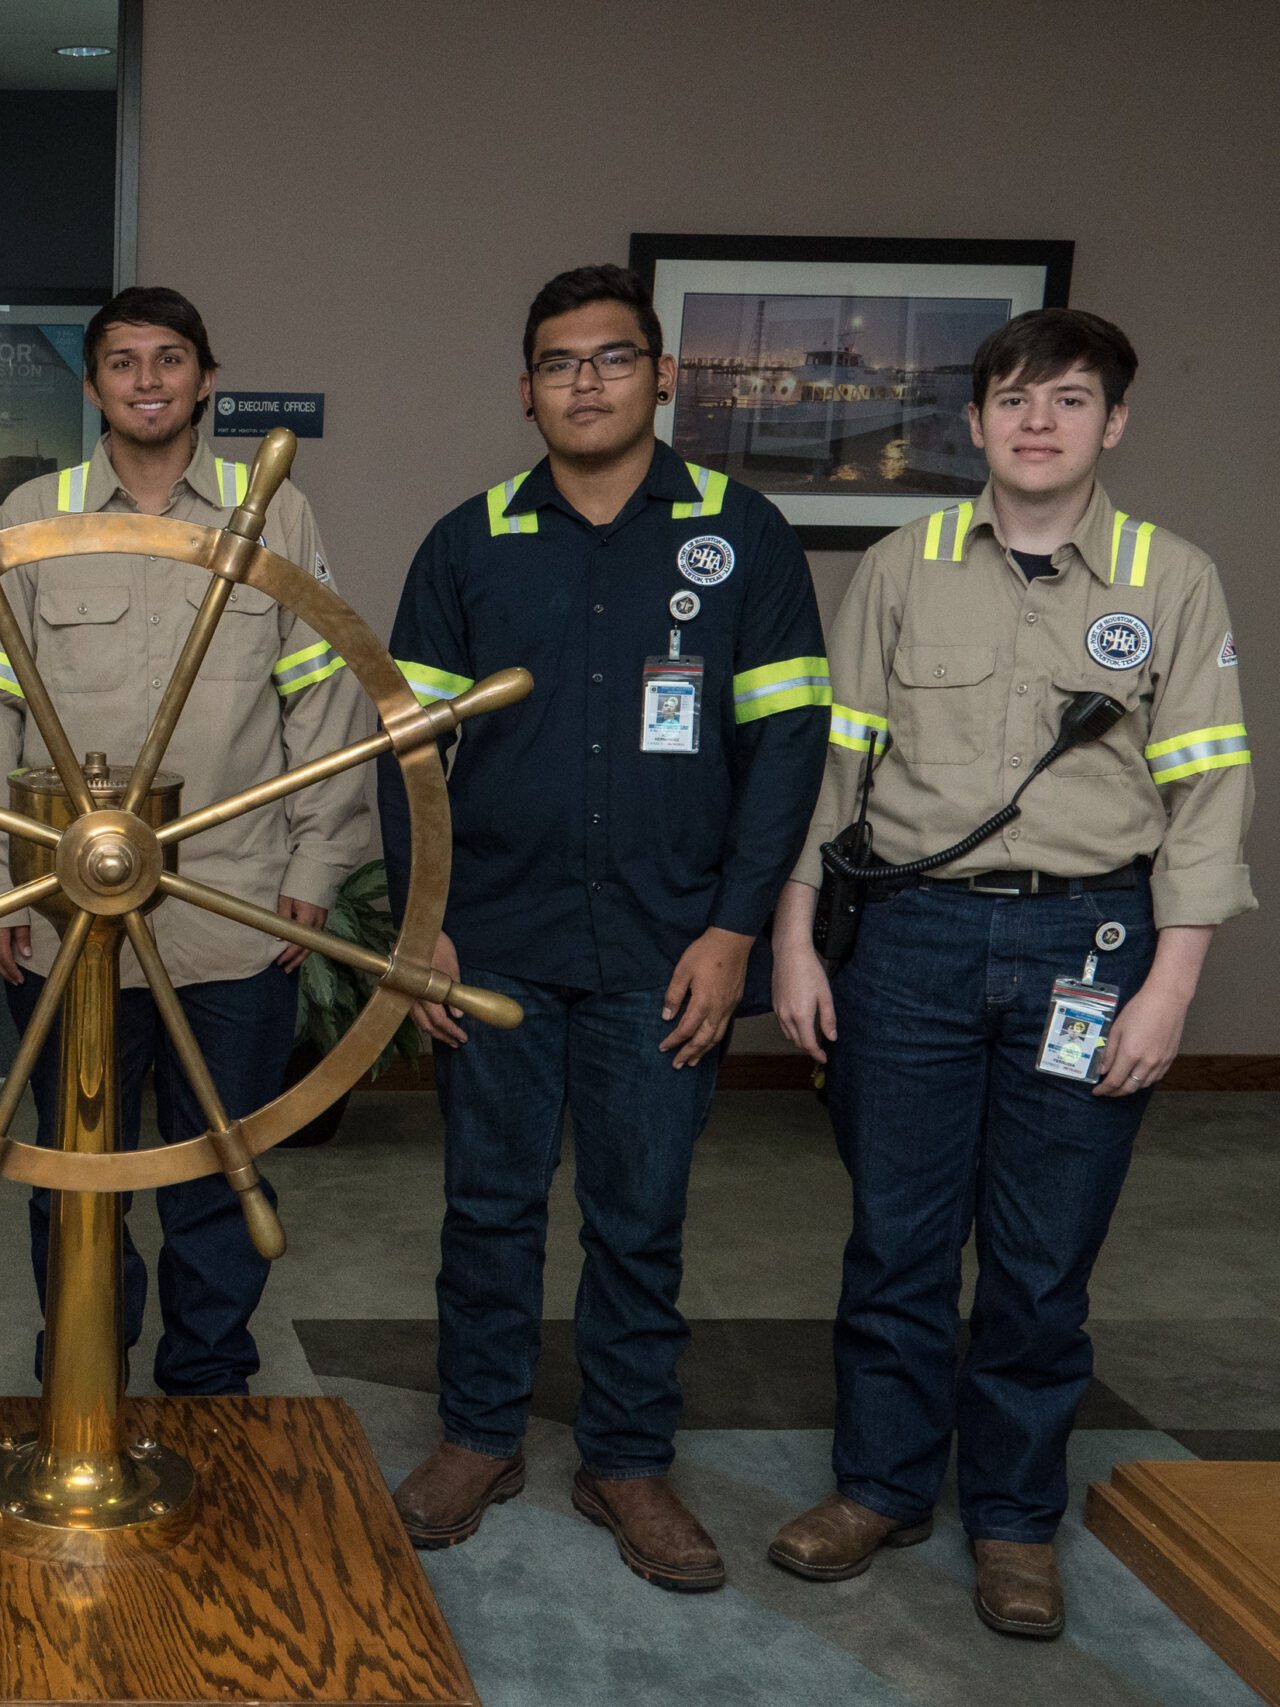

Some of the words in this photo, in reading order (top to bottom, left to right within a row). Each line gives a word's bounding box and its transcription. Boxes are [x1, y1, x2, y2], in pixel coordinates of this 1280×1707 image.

[238, 401, 280, 412] EXECUTIVE
[284, 402, 316, 413] OFFICES
[1103, 616, 1134, 624] HOUSTON
[1102, 629, 1136, 652] PHA
